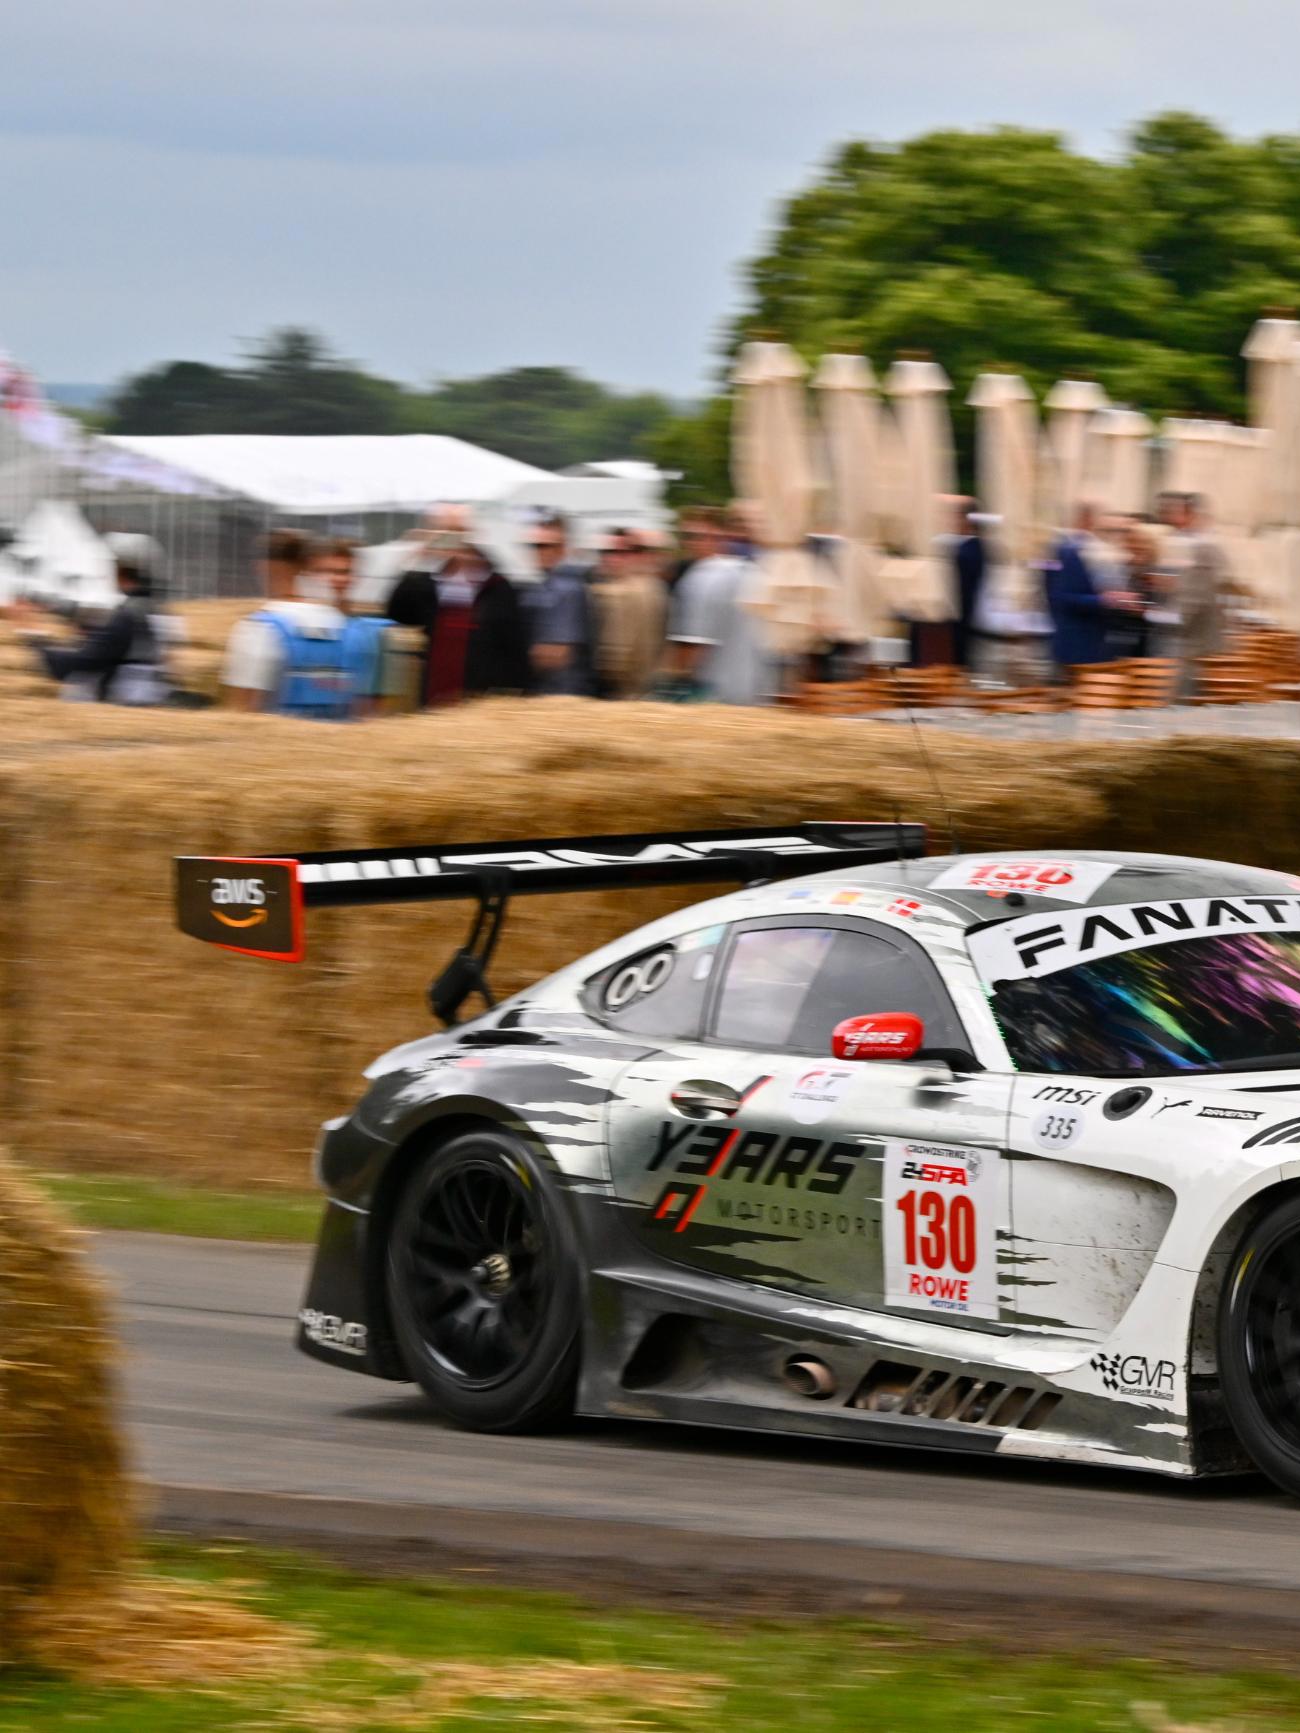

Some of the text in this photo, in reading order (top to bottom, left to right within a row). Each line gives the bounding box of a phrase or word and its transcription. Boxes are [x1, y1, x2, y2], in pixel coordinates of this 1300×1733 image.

[967, 879, 1051, 892] ROWE
[972, 865, 1074, 885] 130
[211, 877, 265, 905] aws
[1032, 1086, 1101, 1105] msi
[1041, 1116, 1077, 1139] 335
[716, 1199, 882, 1239] MOTORSPORT
[896, 1190, 976, 1273] 130
[909, 1273, 969, 1301] ROWE
[1120, 1355, 1176, 1390] GVR
